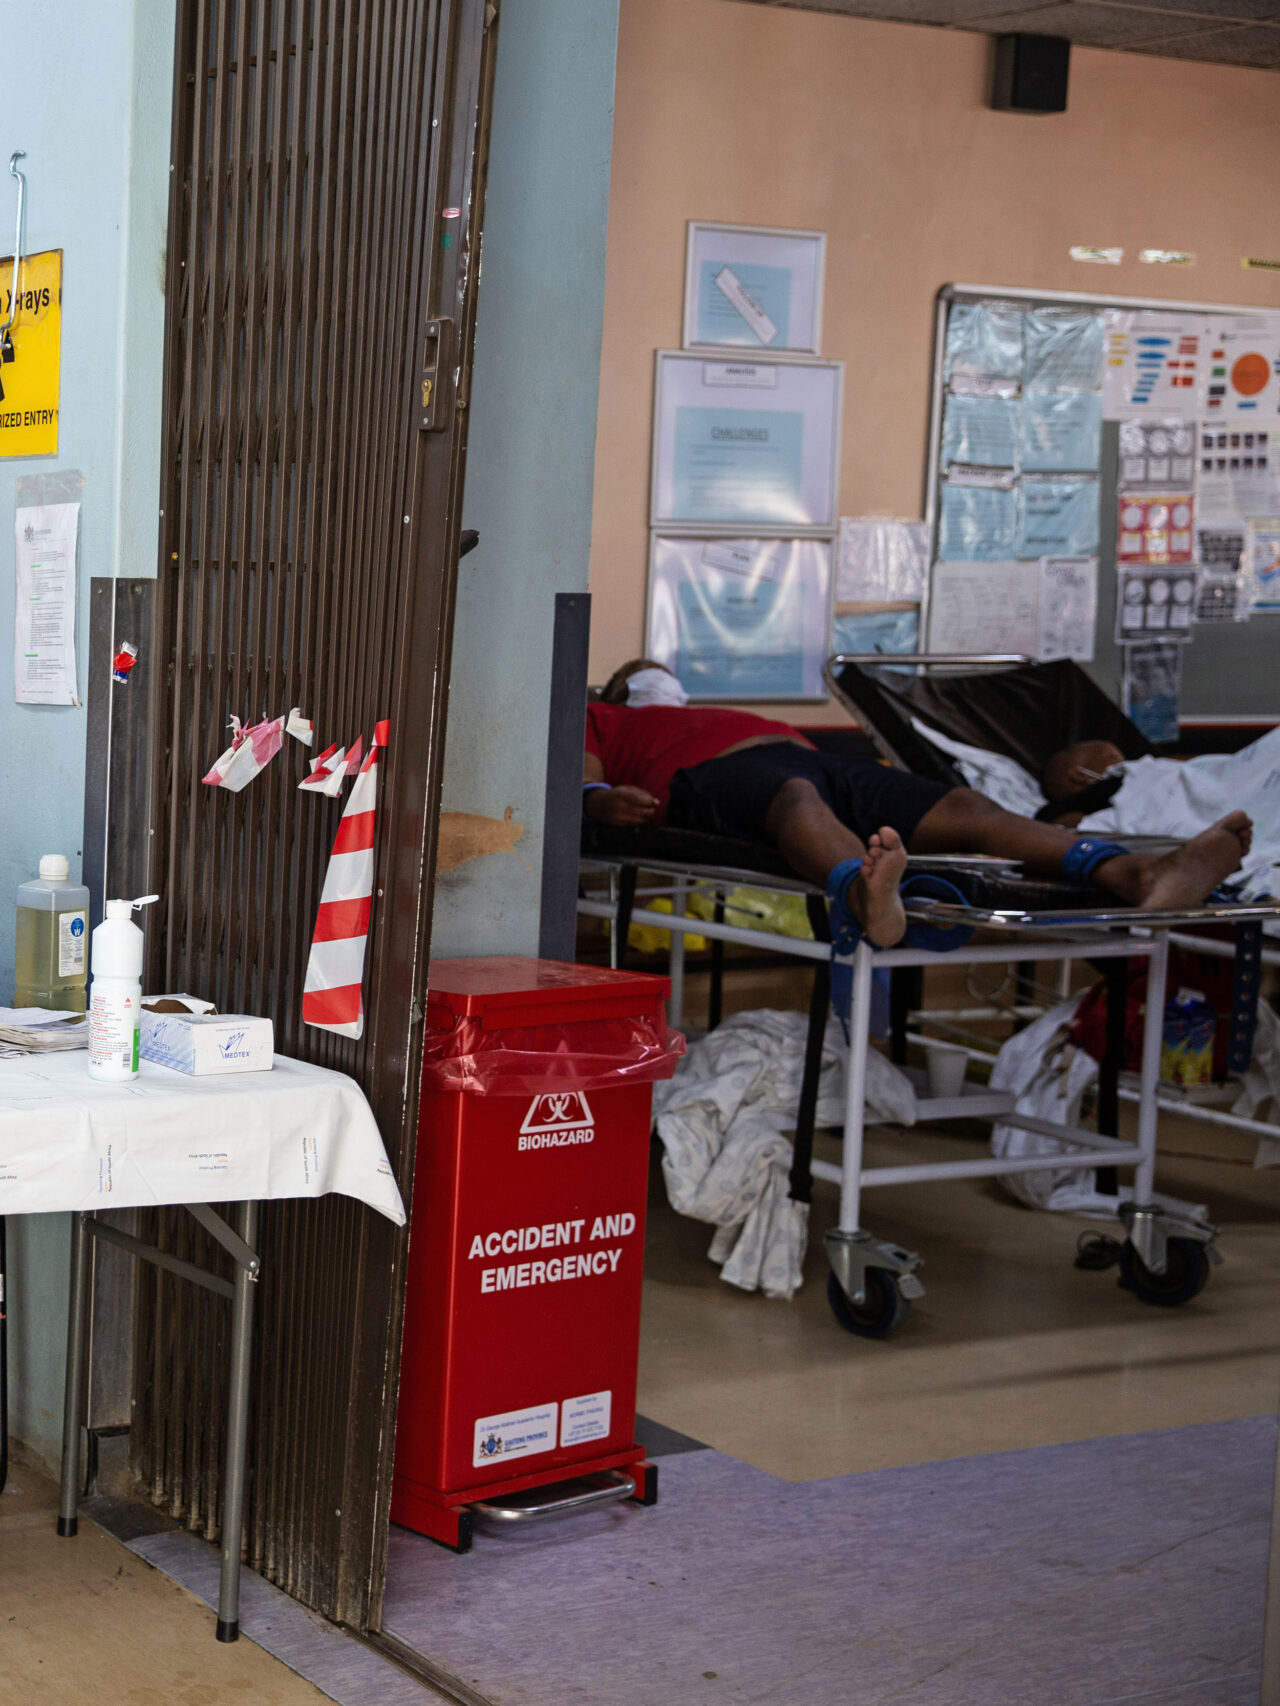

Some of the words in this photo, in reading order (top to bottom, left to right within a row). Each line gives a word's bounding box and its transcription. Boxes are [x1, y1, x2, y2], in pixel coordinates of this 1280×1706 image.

[6, 287, 50, 315] X-rays
[24, 409, 54, 427] ENTRY
[224, 1050, 251, 1060] MEDTEX
[518, 1128, 595, 1151] BIOHAZARD
[468, 1219, 585, 1260] ACCIDENT
[589, 1212, 636, 1241] AND
[481, 1248, 623, 1294] EMERGENCY
